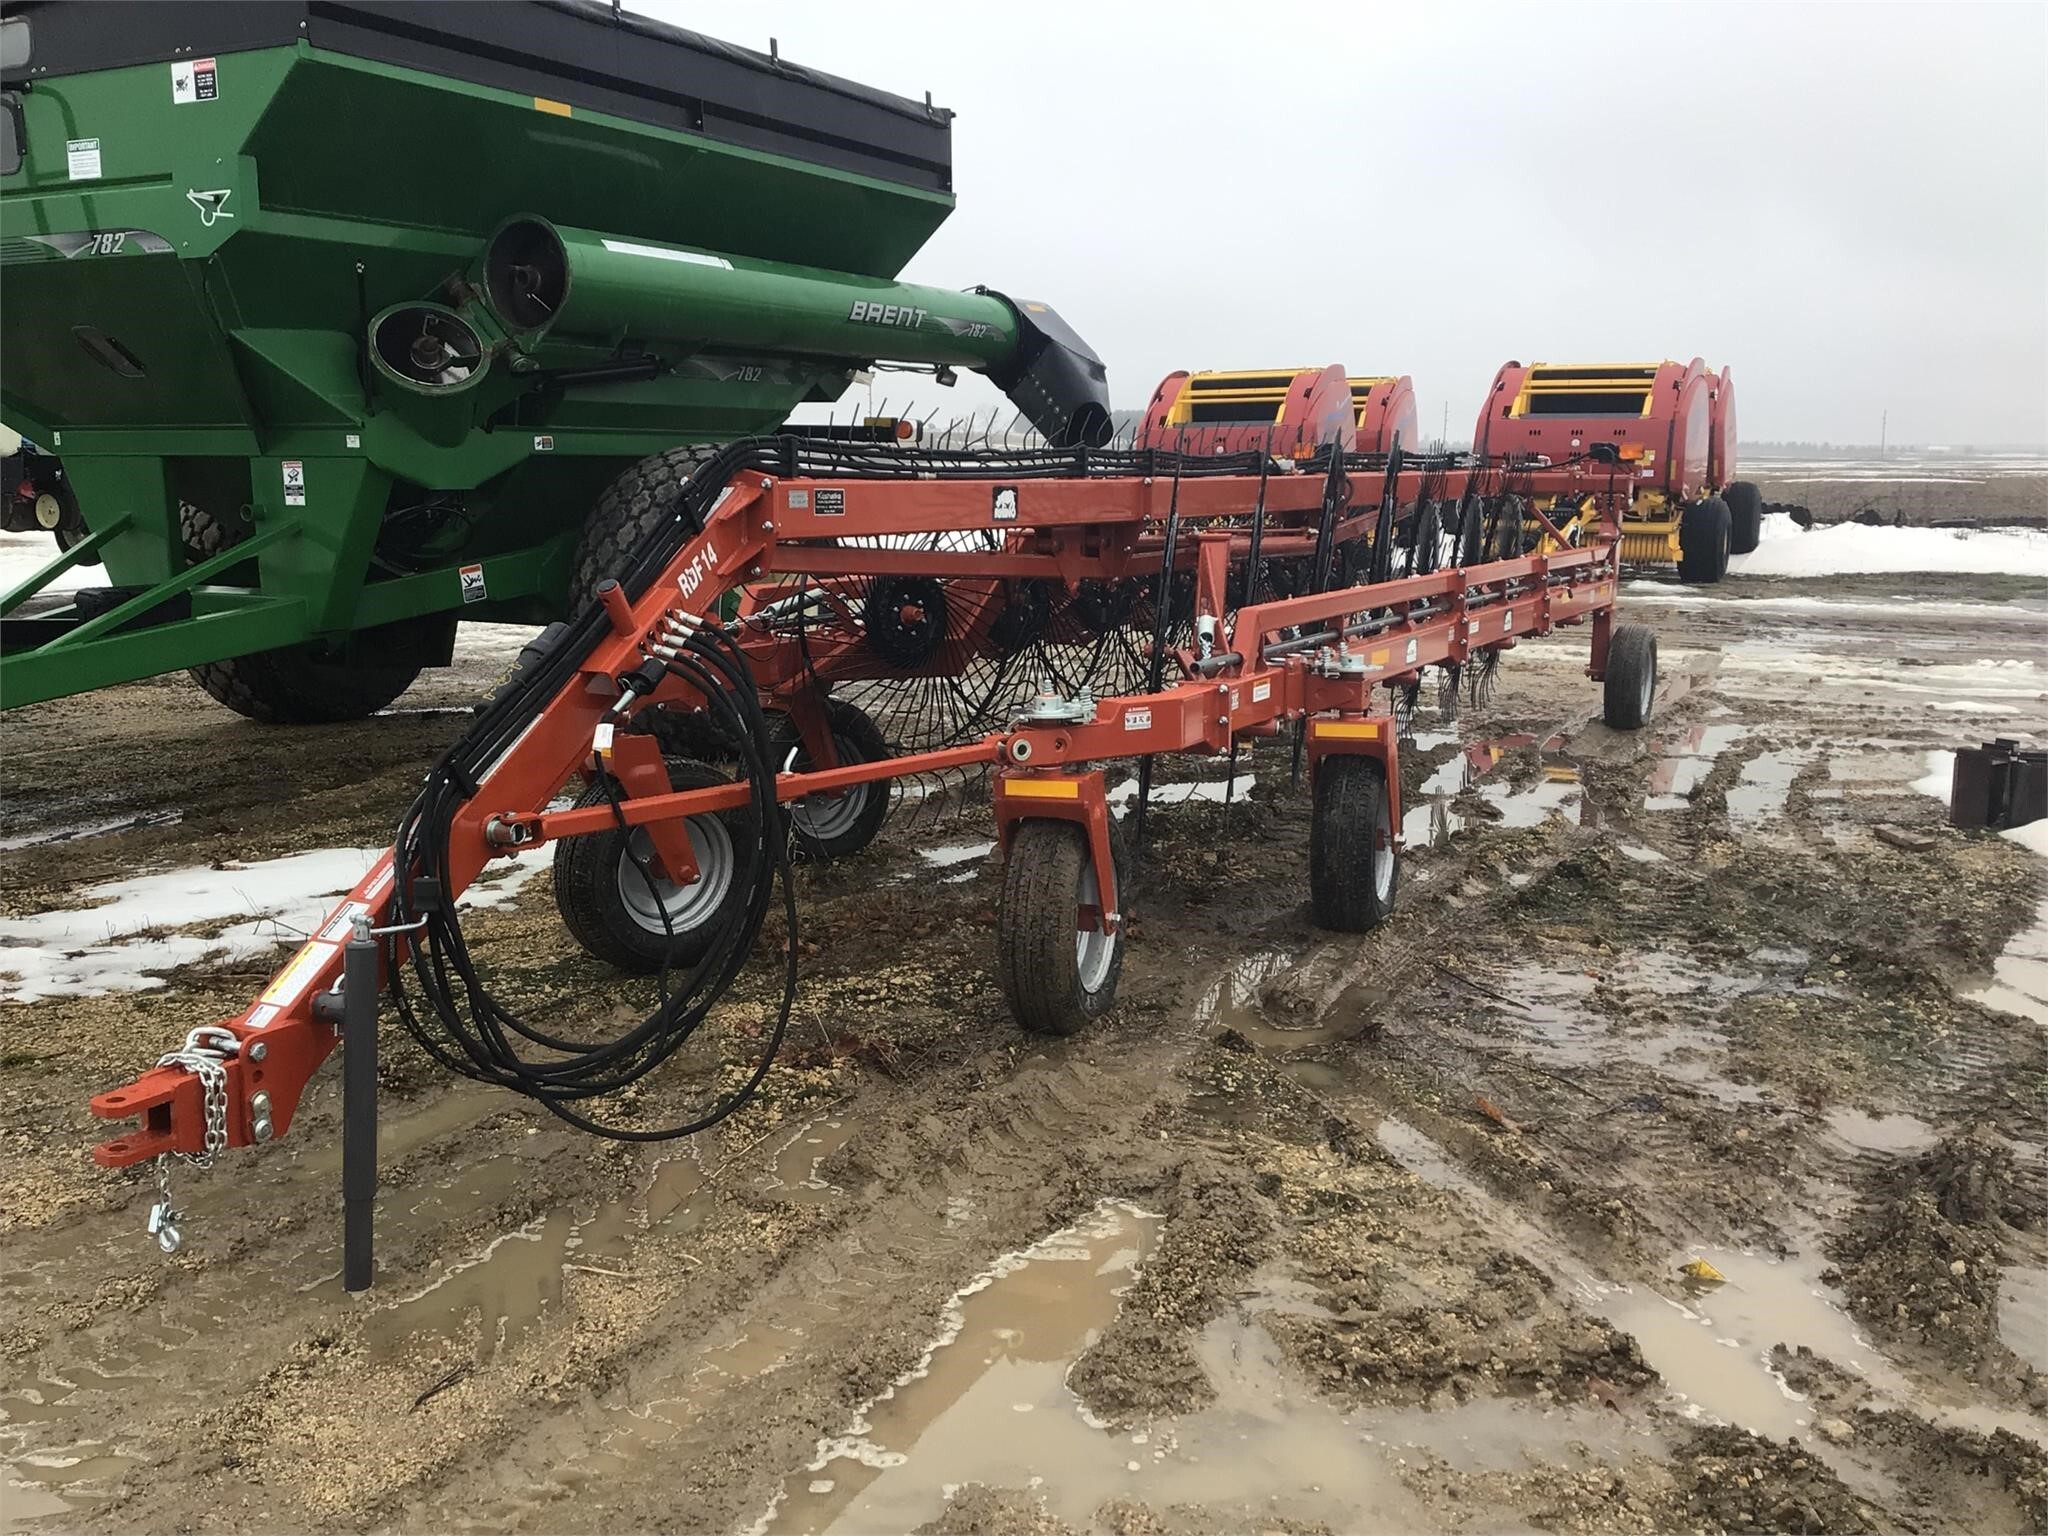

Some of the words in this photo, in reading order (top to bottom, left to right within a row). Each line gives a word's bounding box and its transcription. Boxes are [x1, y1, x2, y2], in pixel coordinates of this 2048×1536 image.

[90, 232, 125, 255] 782
[849, 300, 928, 328] BRENT
[967, 323, 987, 338] 782
[737, 366, 762, 382] 782
